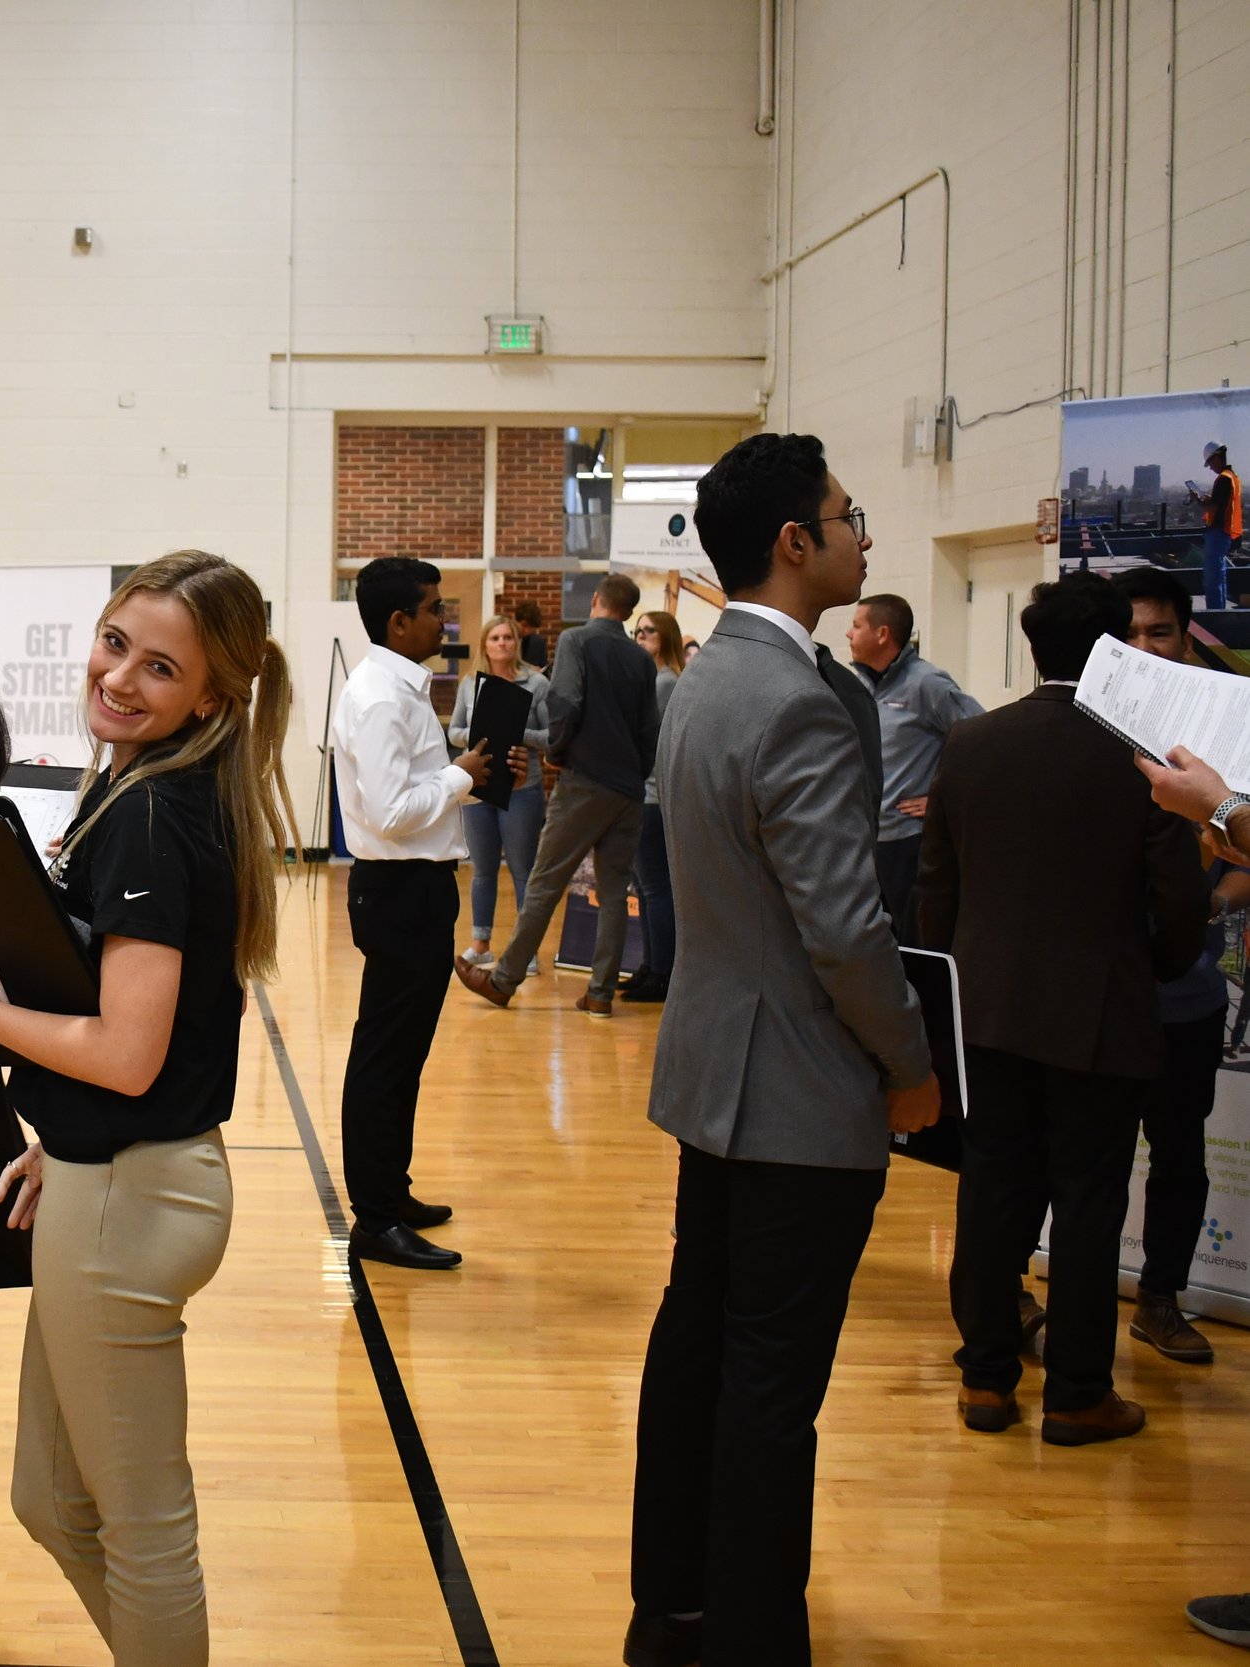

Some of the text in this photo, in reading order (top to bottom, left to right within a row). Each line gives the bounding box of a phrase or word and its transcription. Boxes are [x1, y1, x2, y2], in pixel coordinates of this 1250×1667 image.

[501, 324, 530, 349] EXIT
[25, 623, 72, 658] GET
[1205, 1136, 1241, 1150] assion
